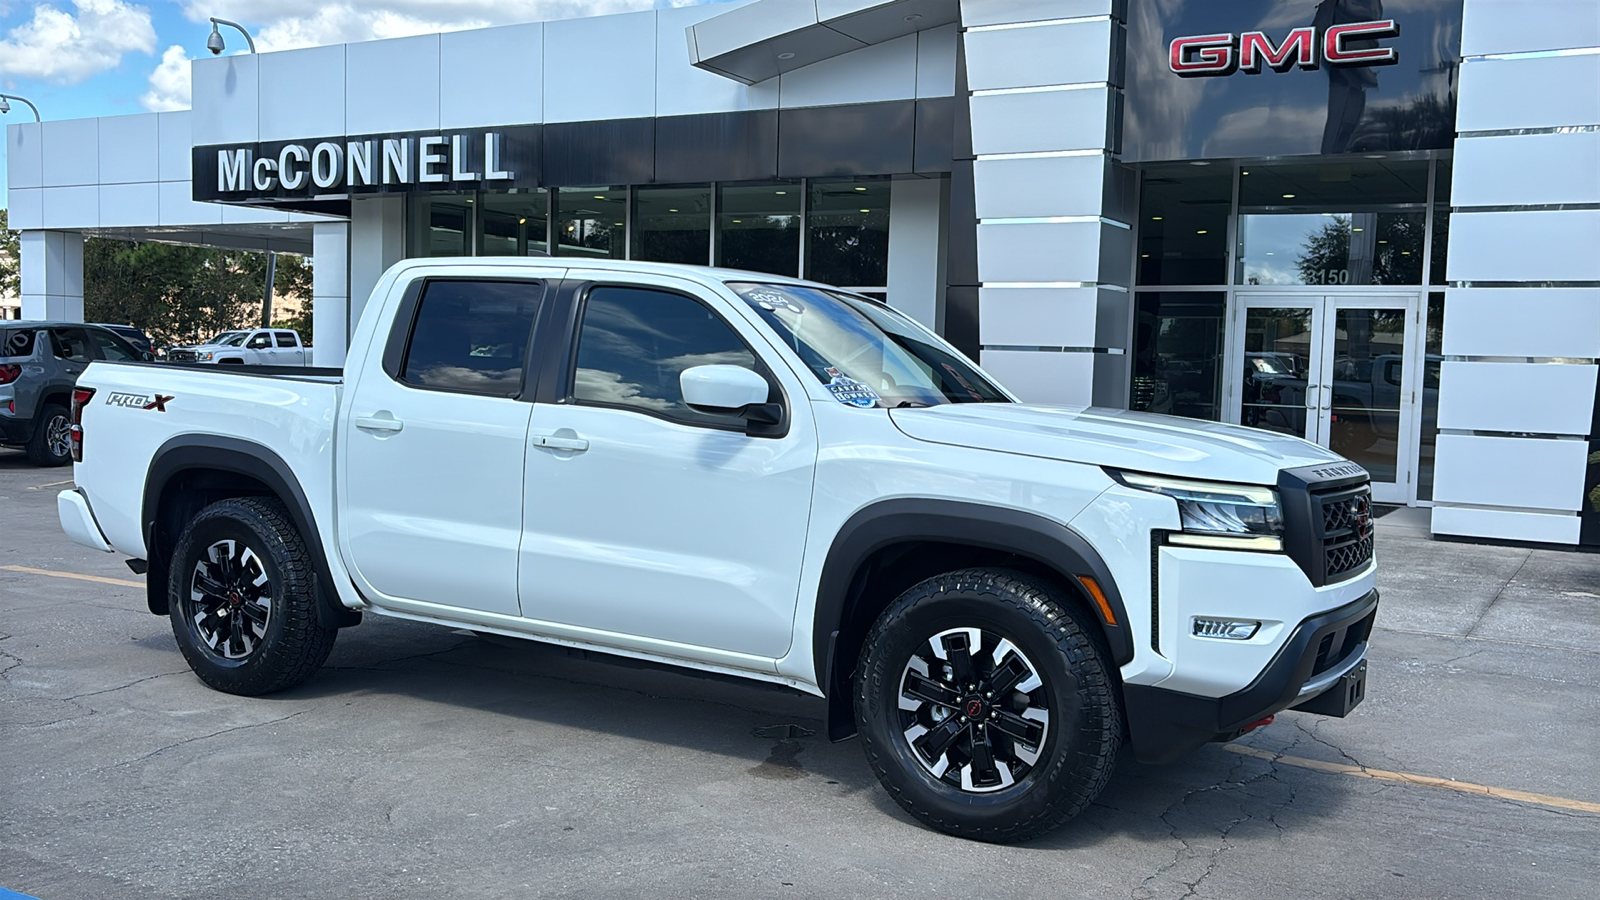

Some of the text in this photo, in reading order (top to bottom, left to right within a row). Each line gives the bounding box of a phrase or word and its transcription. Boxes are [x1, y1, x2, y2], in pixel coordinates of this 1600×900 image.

[1169, 19, 1397, 76] GMC
[217, 132, 514, 192] McCONNELL
[1306, 268, 1349, 285] 3150
[748, 292, 789, 304] 2024
[830, 384, 872, 393] CARFAX
